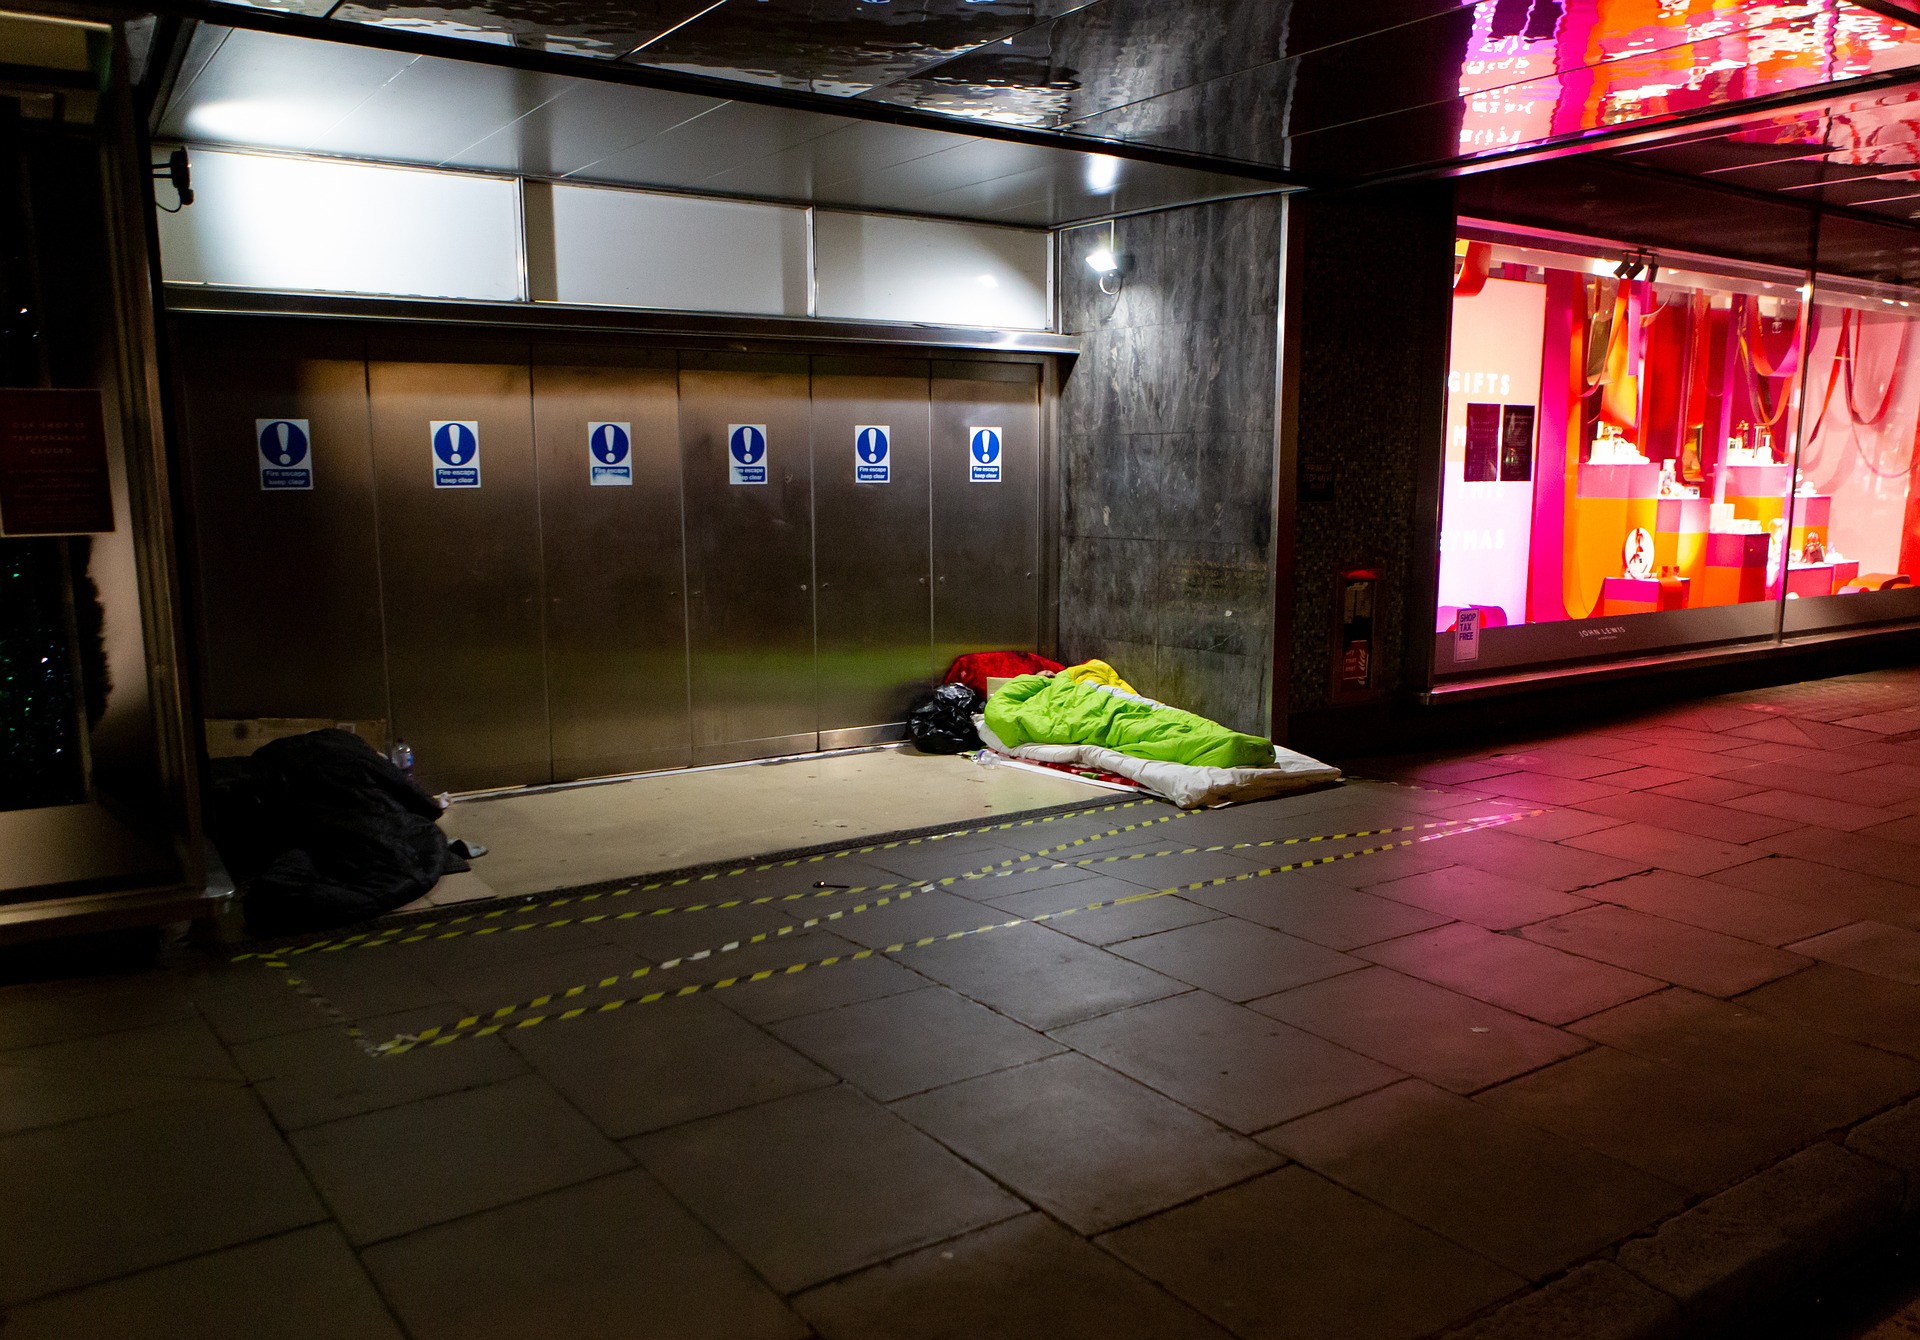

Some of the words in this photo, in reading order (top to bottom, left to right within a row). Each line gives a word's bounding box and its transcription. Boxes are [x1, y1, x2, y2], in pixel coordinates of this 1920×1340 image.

[1448, 371, 1510, 396] GIFTS
[1460, 613, 1476, 622] SHOP
[1459, 623, 1472, 631] TAX
[1458, 632, 1474, 641] FREE
[1578, 629, 1601, 638] JOHN
[1600, 626, 1626, 635] LEWIS
